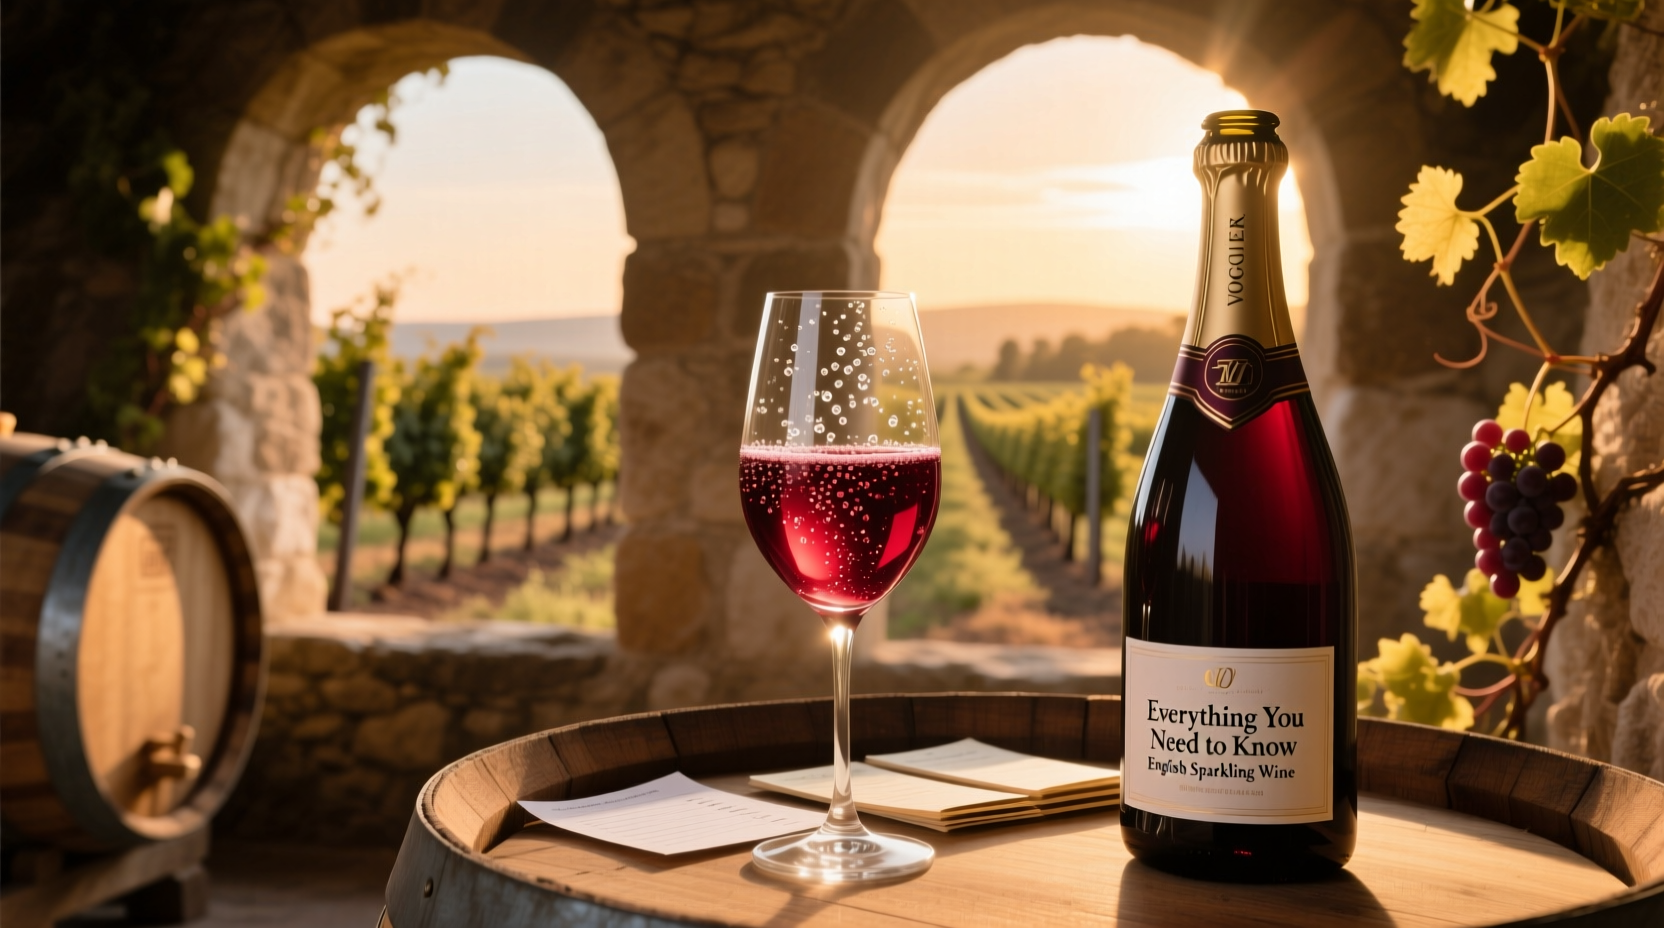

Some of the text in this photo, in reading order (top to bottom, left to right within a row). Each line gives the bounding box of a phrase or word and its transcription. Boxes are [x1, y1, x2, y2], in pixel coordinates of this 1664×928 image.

[1147, 699, 1305, 735] Everything You
[1150, 728, 1298, 757] Need to Know
[1147, 756, 1296, 783] English Sparkling Wine
